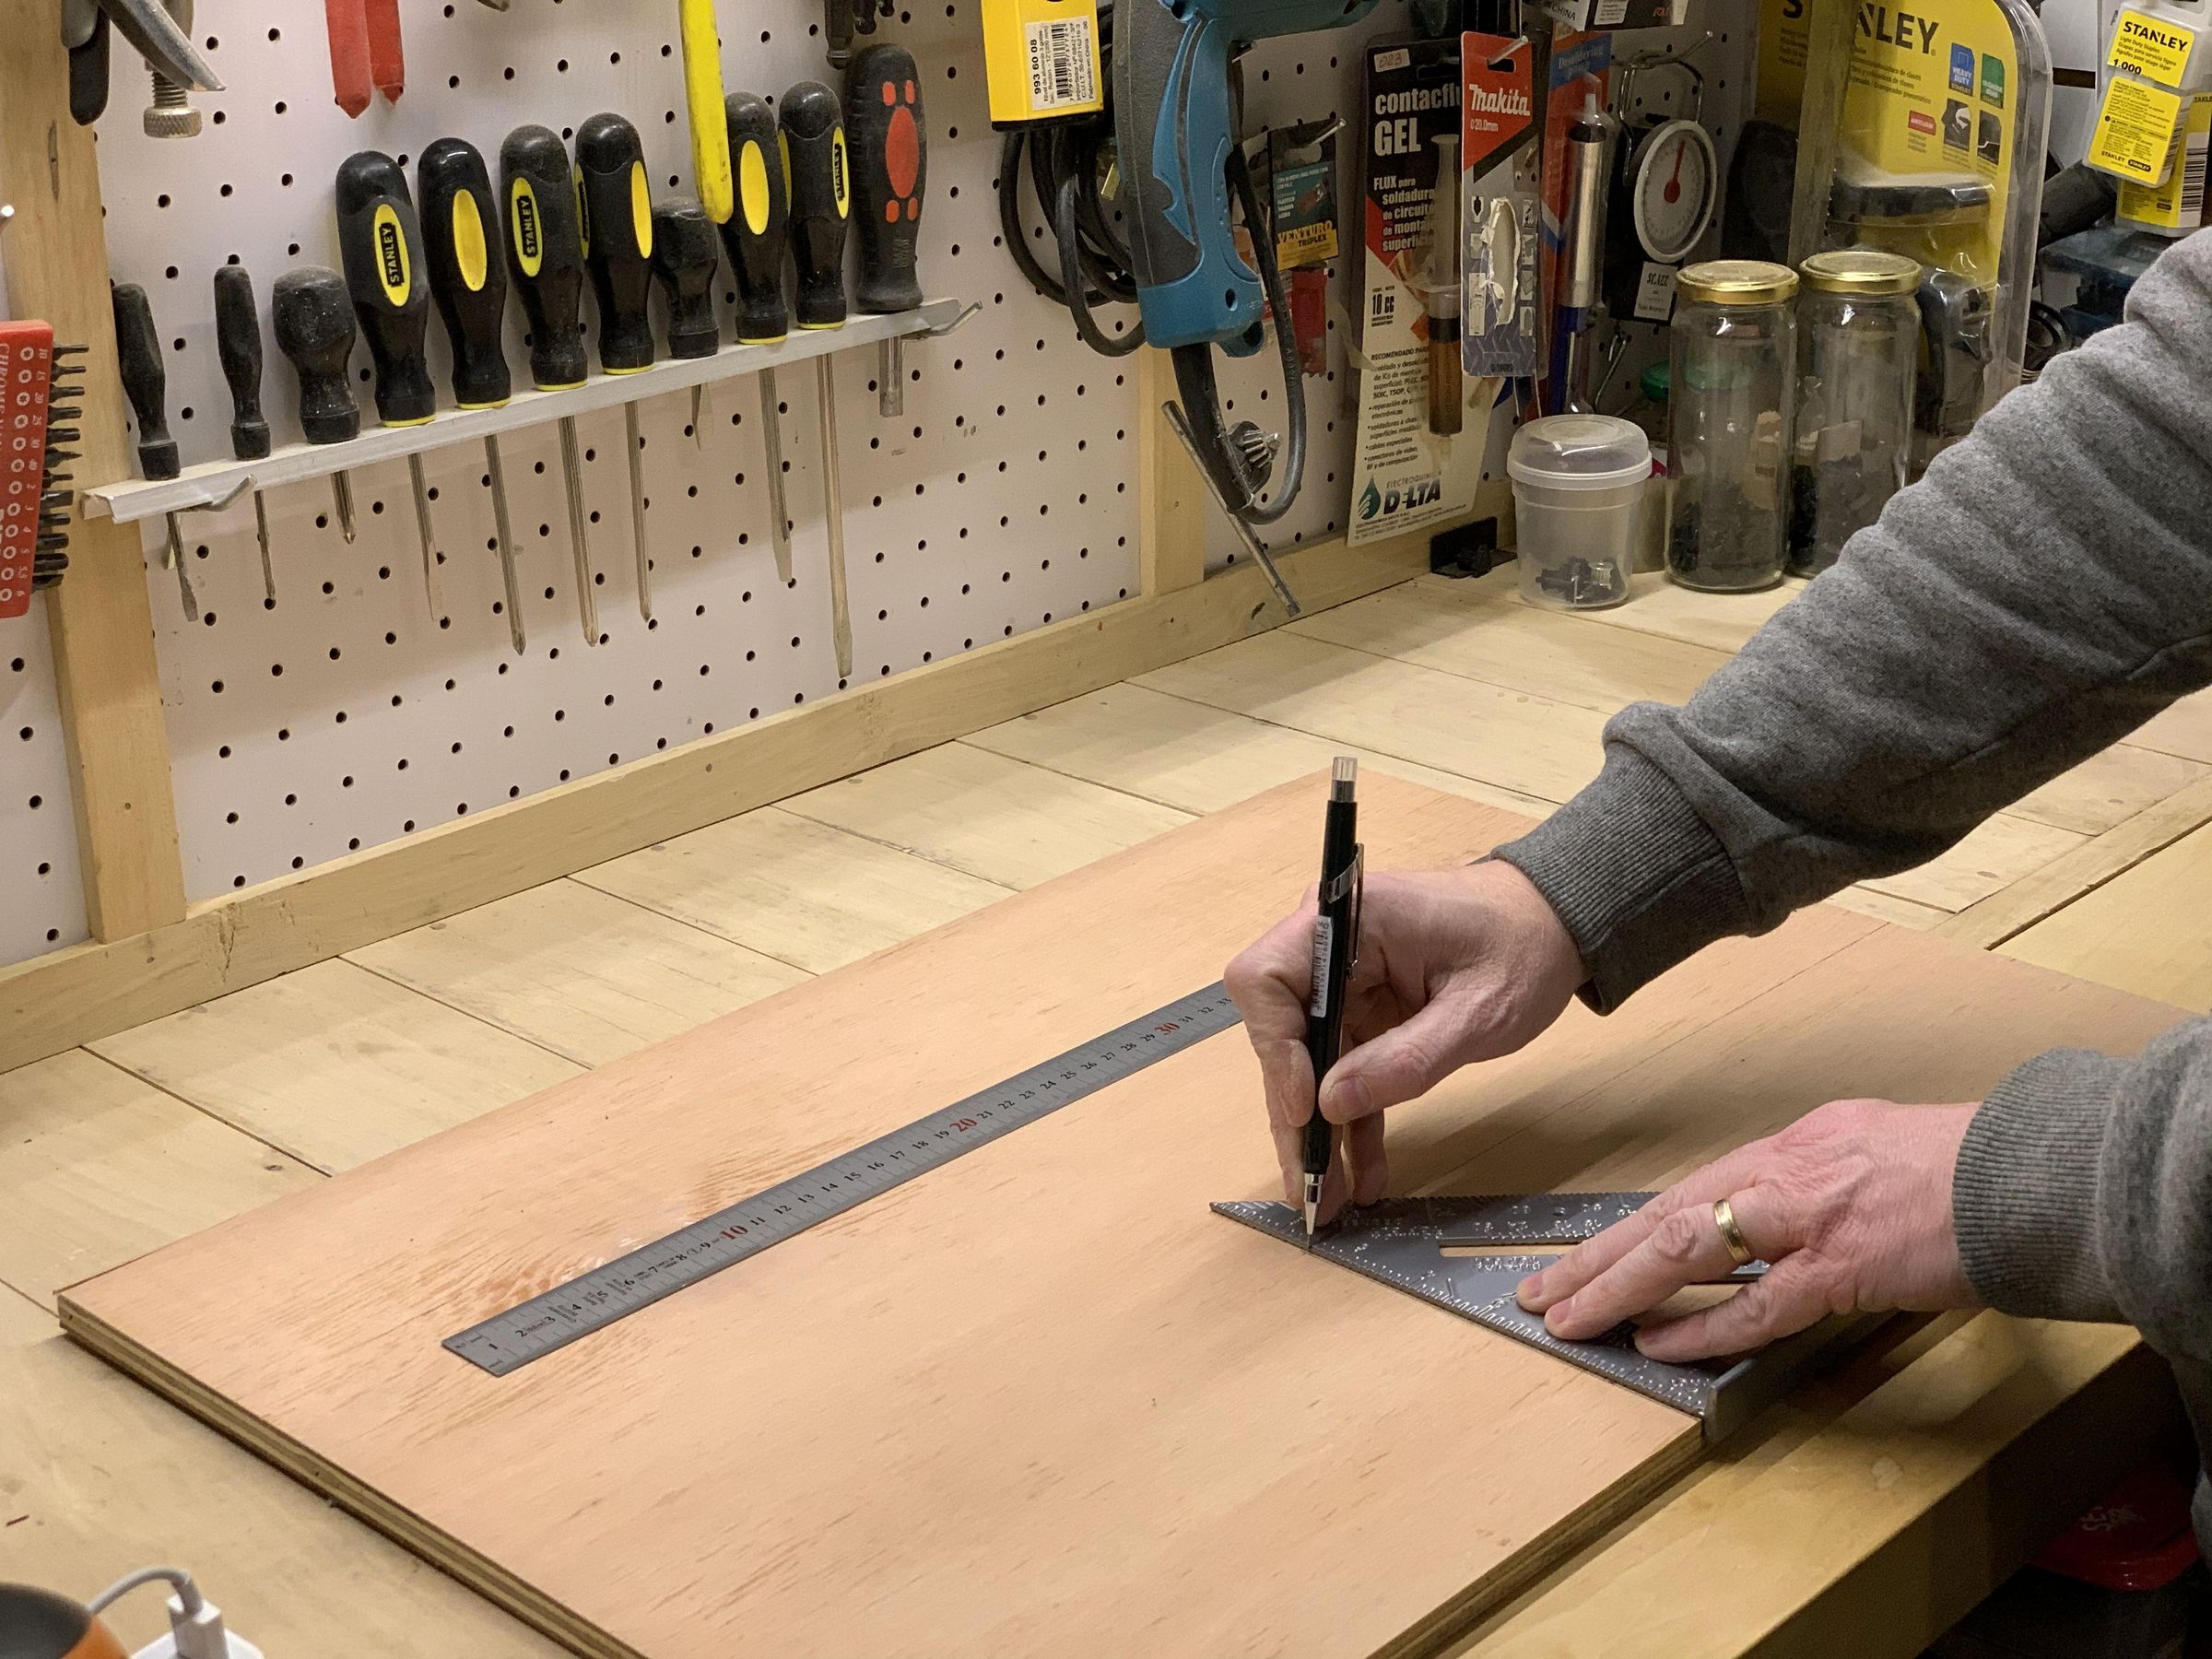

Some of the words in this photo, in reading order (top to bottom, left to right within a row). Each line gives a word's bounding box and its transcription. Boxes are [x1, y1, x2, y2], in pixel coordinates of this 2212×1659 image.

[2123, 21, 2188, 52] STANLEY
[1030, 39, 1038, 53] 08
[2120, 35, 2131, 44] Light
[2132, 39, 2143, 48] Duty
[2144, 43, 2160, 53] Staples
[2134, 47, 2145, 56] para
[2146, 51, 2162, 62] servicio
[1032, 57, 1039, 70] 60
[2113, 59, 2142, 75] 1.000
[1952, 66, 1972, 79] HEAVY
[1033, 74, 1041, 94] 993
[1953, 74, 1970, 86] DUTY
[1469, 83, 1531, 117] Makita
[1374, 117, 1422, 157] GEL
[2101, 150, 2126, 162] STANLEY
[1373, 175, 1397, 190] FLUX
[1398, 178, 1416, 187] para
[1382, 188, 1435, 206] soldadura
[1383, 211, 1392, 221] de
[521, 199, 535, 254] STANLEY
[1277, 220, 1333, 244] VENTURO
[1383, 227, 1392, 237] de
[1297, 233, 1328, 247] TRIPLEX
[382, 227, 400, 283] STANLEY
[1372, 294, 1382, 315] 10
[1384, 295, 1394, 313] cc
[38, 347, 48, 359] 10
[1371, 348, 1414, 361] RECOMENDADO
[36, 371, 46, 381] 15
[35, 392, 44, 404] 20
[1373, 390, 1389, 400] SOIC,
[1390, 388, 1406, 396] TSOP,
[32, 414, 42, 425] 25
[31, 437, 41, 449] 30
[1386, 437, 1413, 447] especiales
[1367, 452, 1395, 462] conectores
[29, 459, 38, 471] 40
[1383, 478, 1441, 515] DELTA
[488, 1342, 498, 1350] 1
[515, 1330, 528, 1338] 2
[572, 1303, 582, 1312] 4
[597, 1290, 609, 1298] 5
[624, 1277, 635, 1286] 6
[675, 1253, 688, 1261] 8
[719, 1225, 748, 1240] 10
[750, 1217, 766, 1226] 11
[774, 1205, 792, 1215] 12
[797, 1194, 815, 1203] 13
[821, 1182, 839, 1192] 14
[843, 1171, 862, 1182] 15
[867, 1161, 885, 1171] 16
[889, 1150, 906, 1160] 17
[912, 1140, 930, 1150] 18
[934, 1130, 950, 1139] 19
[949, 1118, 978, 1133] 20
[977, 1110, 993, 1119] 21
[998, 1100, 1016, 1110] 22
[1019, 1090, 1036, 1100] 23
[1040, 1080, 1057, 1089] 24
[1060, 1071, 1077, 1080] 25
[1080, 1061, 1098, 1071] 26
[1100, 1051, 1117, 1061] 27
[1120, 1042, 1137, 1051] 28
[1140, 1033, 1156, 1042] 29
[1154, 1022, 1181, 1035] 30
[1197, 1006, 1214, 1015] 32
